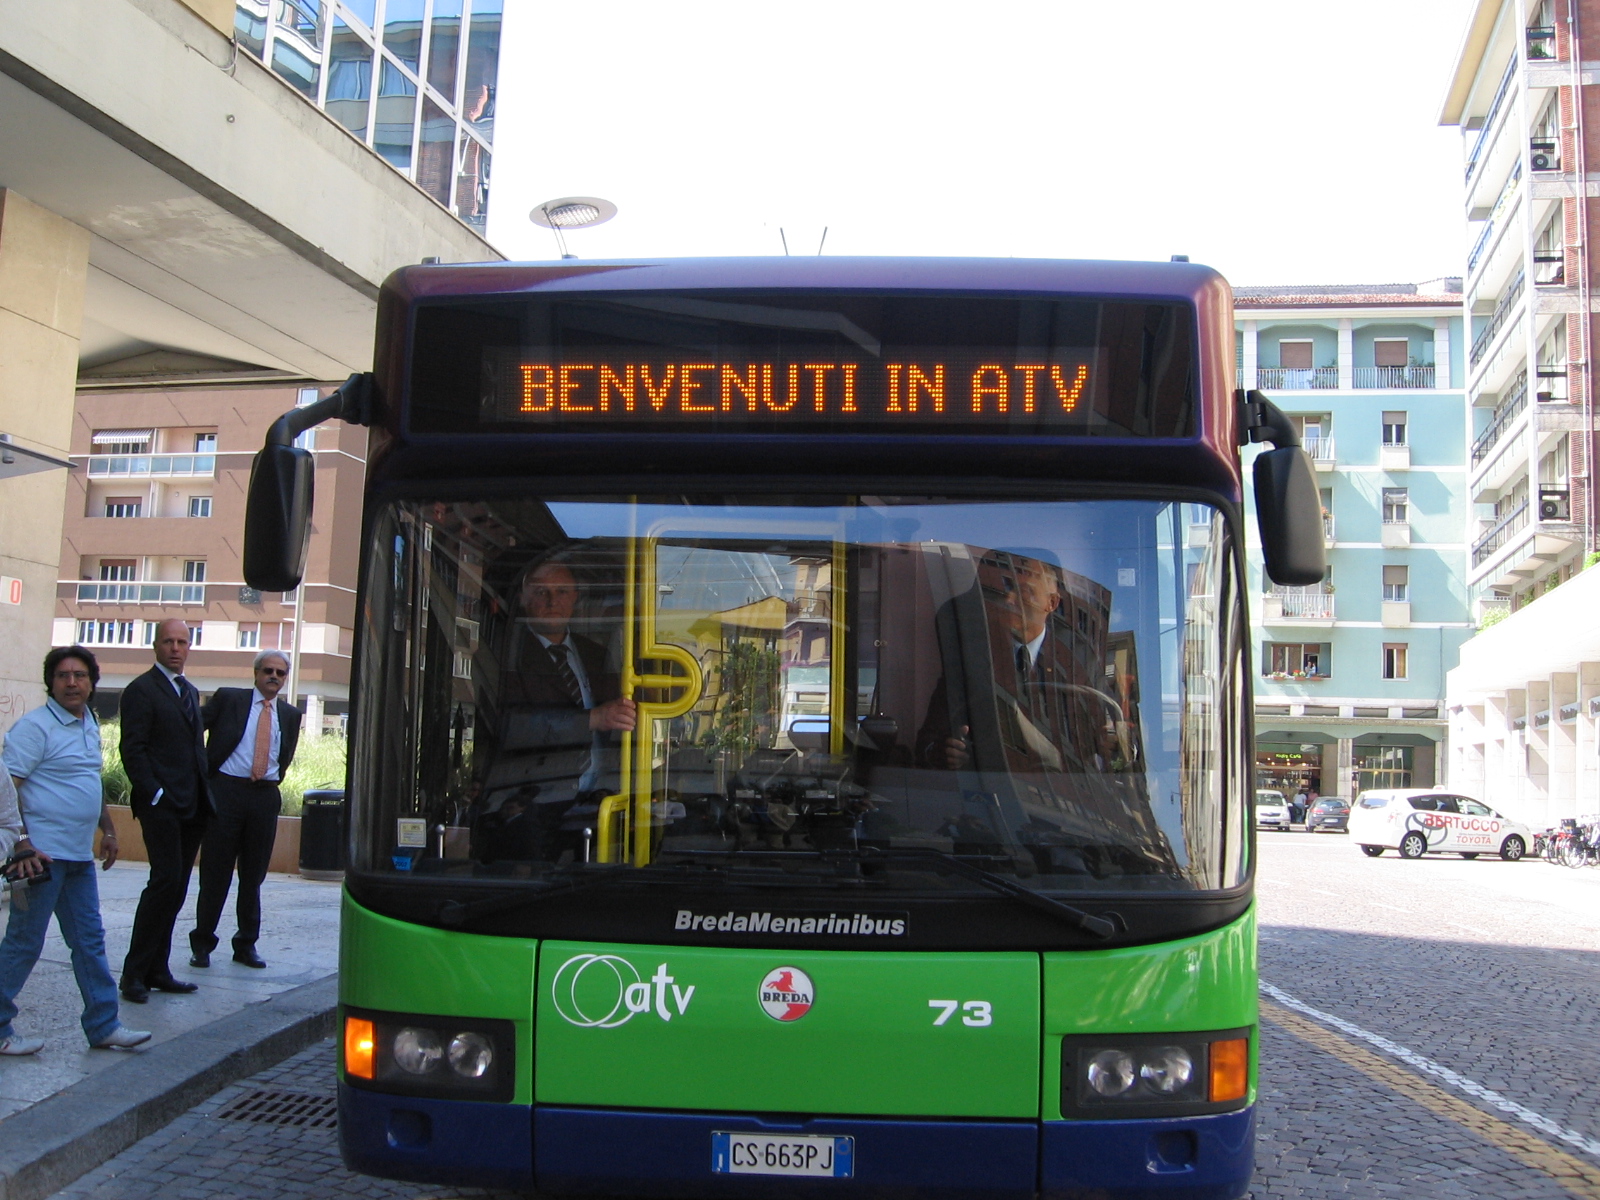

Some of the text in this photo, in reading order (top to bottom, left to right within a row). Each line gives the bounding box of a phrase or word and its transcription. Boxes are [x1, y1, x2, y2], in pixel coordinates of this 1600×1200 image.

[520, 364, 1088, 412] BENVENUTI IN ATV
[1425, 813, 1500, 833] BERTUCCO
[1456, 835, 1492, 844] TOYOTA
[674, 910, 905, 935] BredaMenarinibus
[624, 962, 696, 1022] atv
[762, 991, 811, 1004] BREDA
[928, 999, 993, 1027] 73
